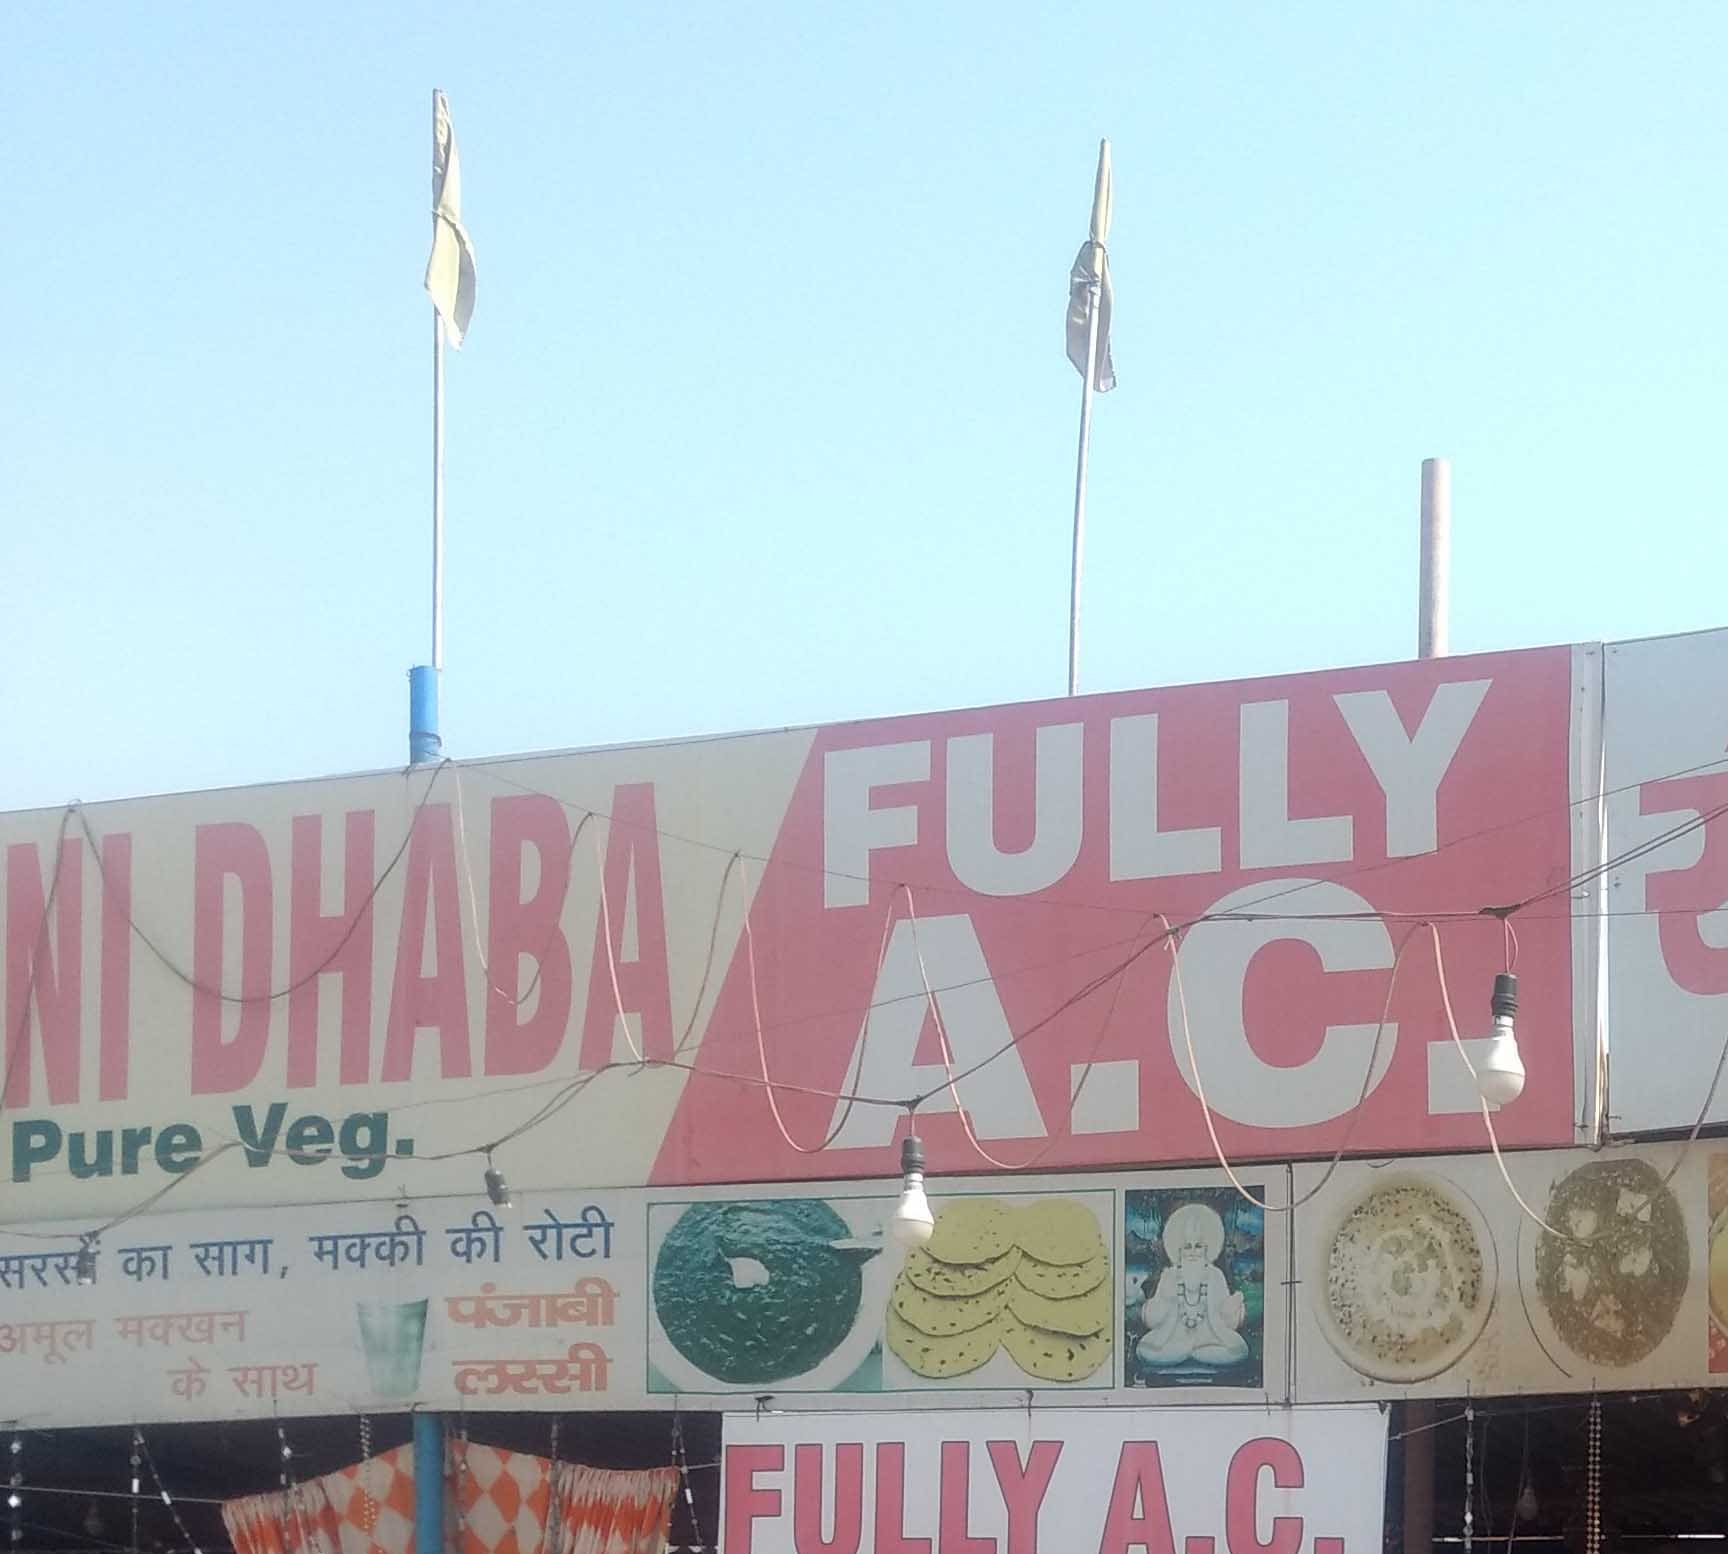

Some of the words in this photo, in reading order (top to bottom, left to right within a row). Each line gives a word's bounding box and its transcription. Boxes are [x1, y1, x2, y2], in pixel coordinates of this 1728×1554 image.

[823, 678, 1494, 910] FULLY
[190, 782, 676, 1097] DHABA
[823, 878, 1502, 1151] A.C.
[11, 1119, 204, 1184] Pure
[231, 1102, 415, 1181] Veg.
[118, 1245, 173, 1282] का
[308, 1214, 427, 1271] मक्की
[445, 1210, 504, 1264] की
[522, 1204, 616, 1261] रोटी
[0, 1318, 97, 1365] अमूल
[112, 1309, 250, 1347] मक्खन
[443, 1276, 621, 1329] पंजाबी
[165, 1355, 211, 1401] के
[226, 1362, 319, 1399] साथ
[451, 1341, 614, 1395] लस्सी
